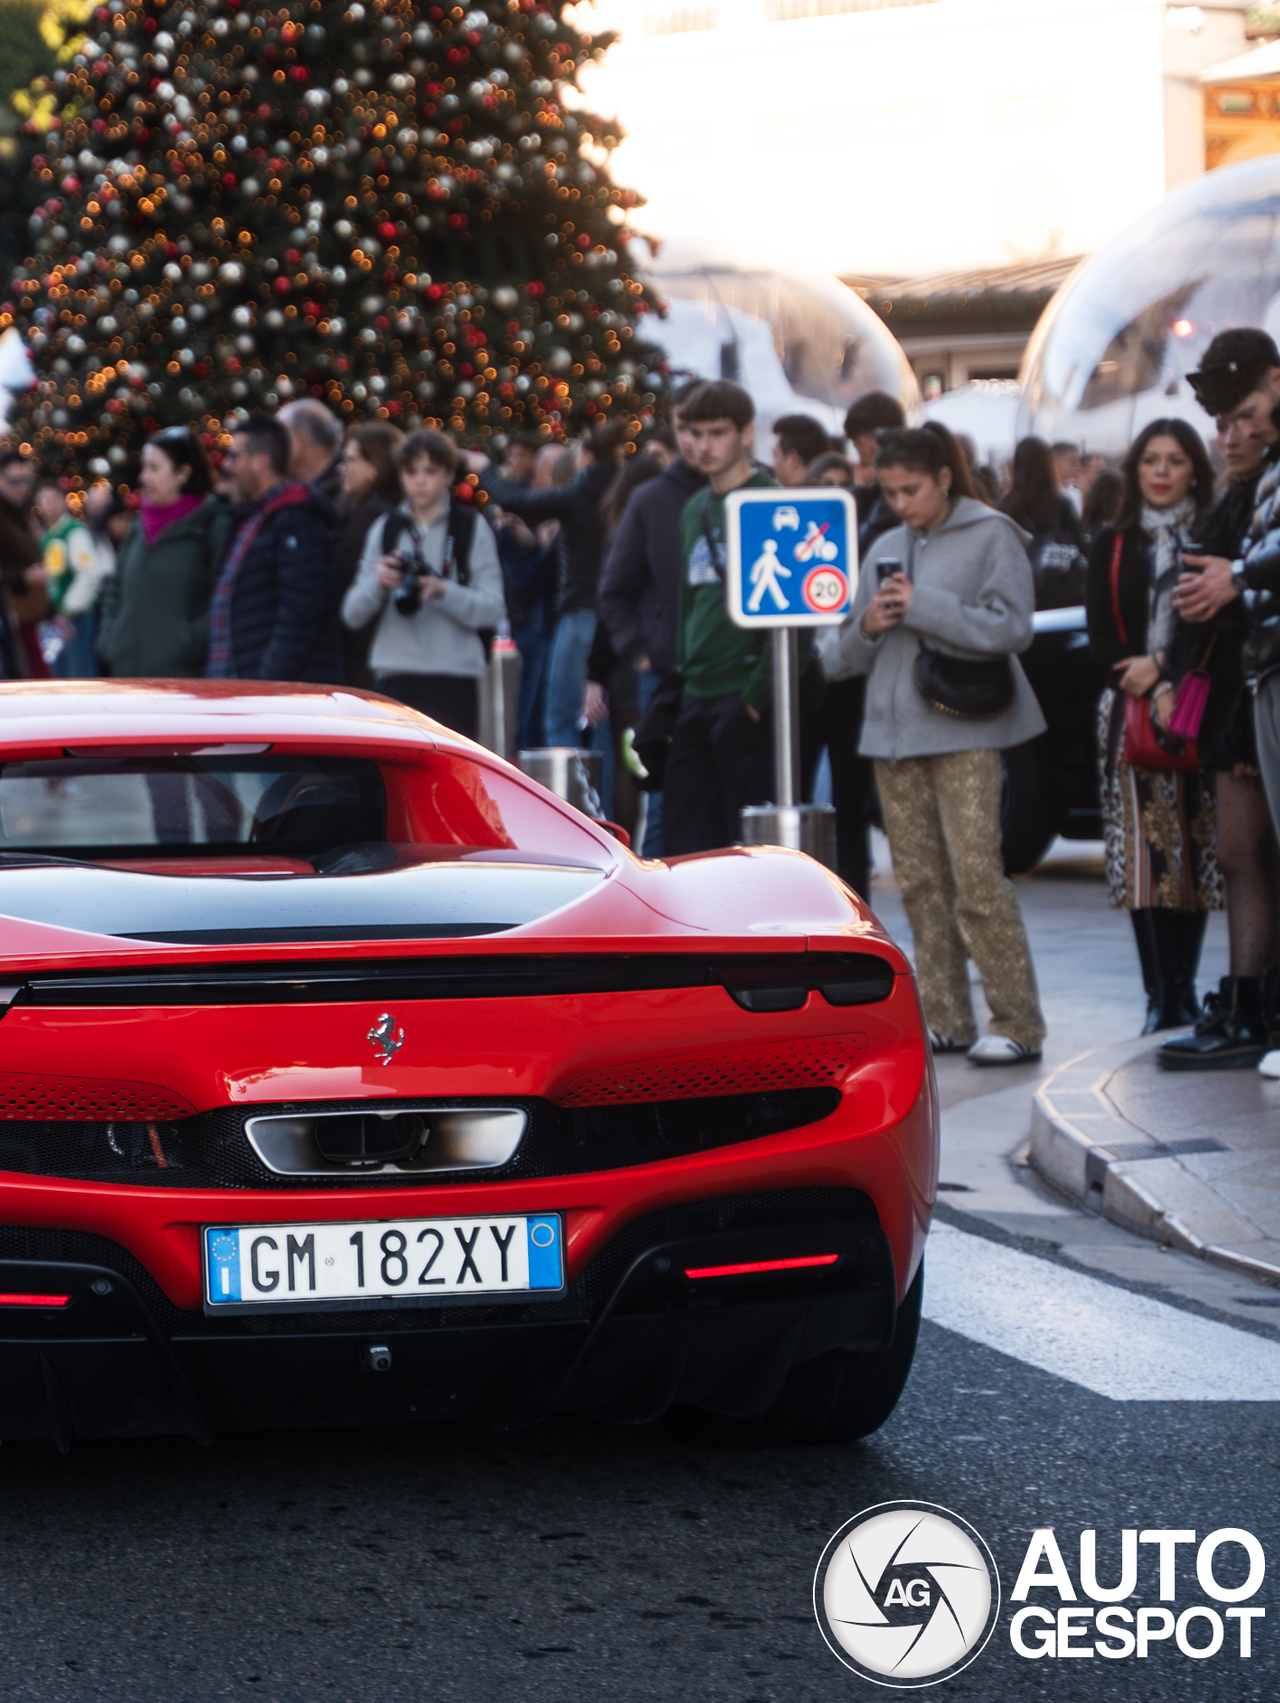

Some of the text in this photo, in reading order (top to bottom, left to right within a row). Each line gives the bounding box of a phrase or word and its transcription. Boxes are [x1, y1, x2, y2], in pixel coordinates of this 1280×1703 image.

[815, 580, 839, 598] 20
[250, 1225, 517, 1293] GM 182XY
